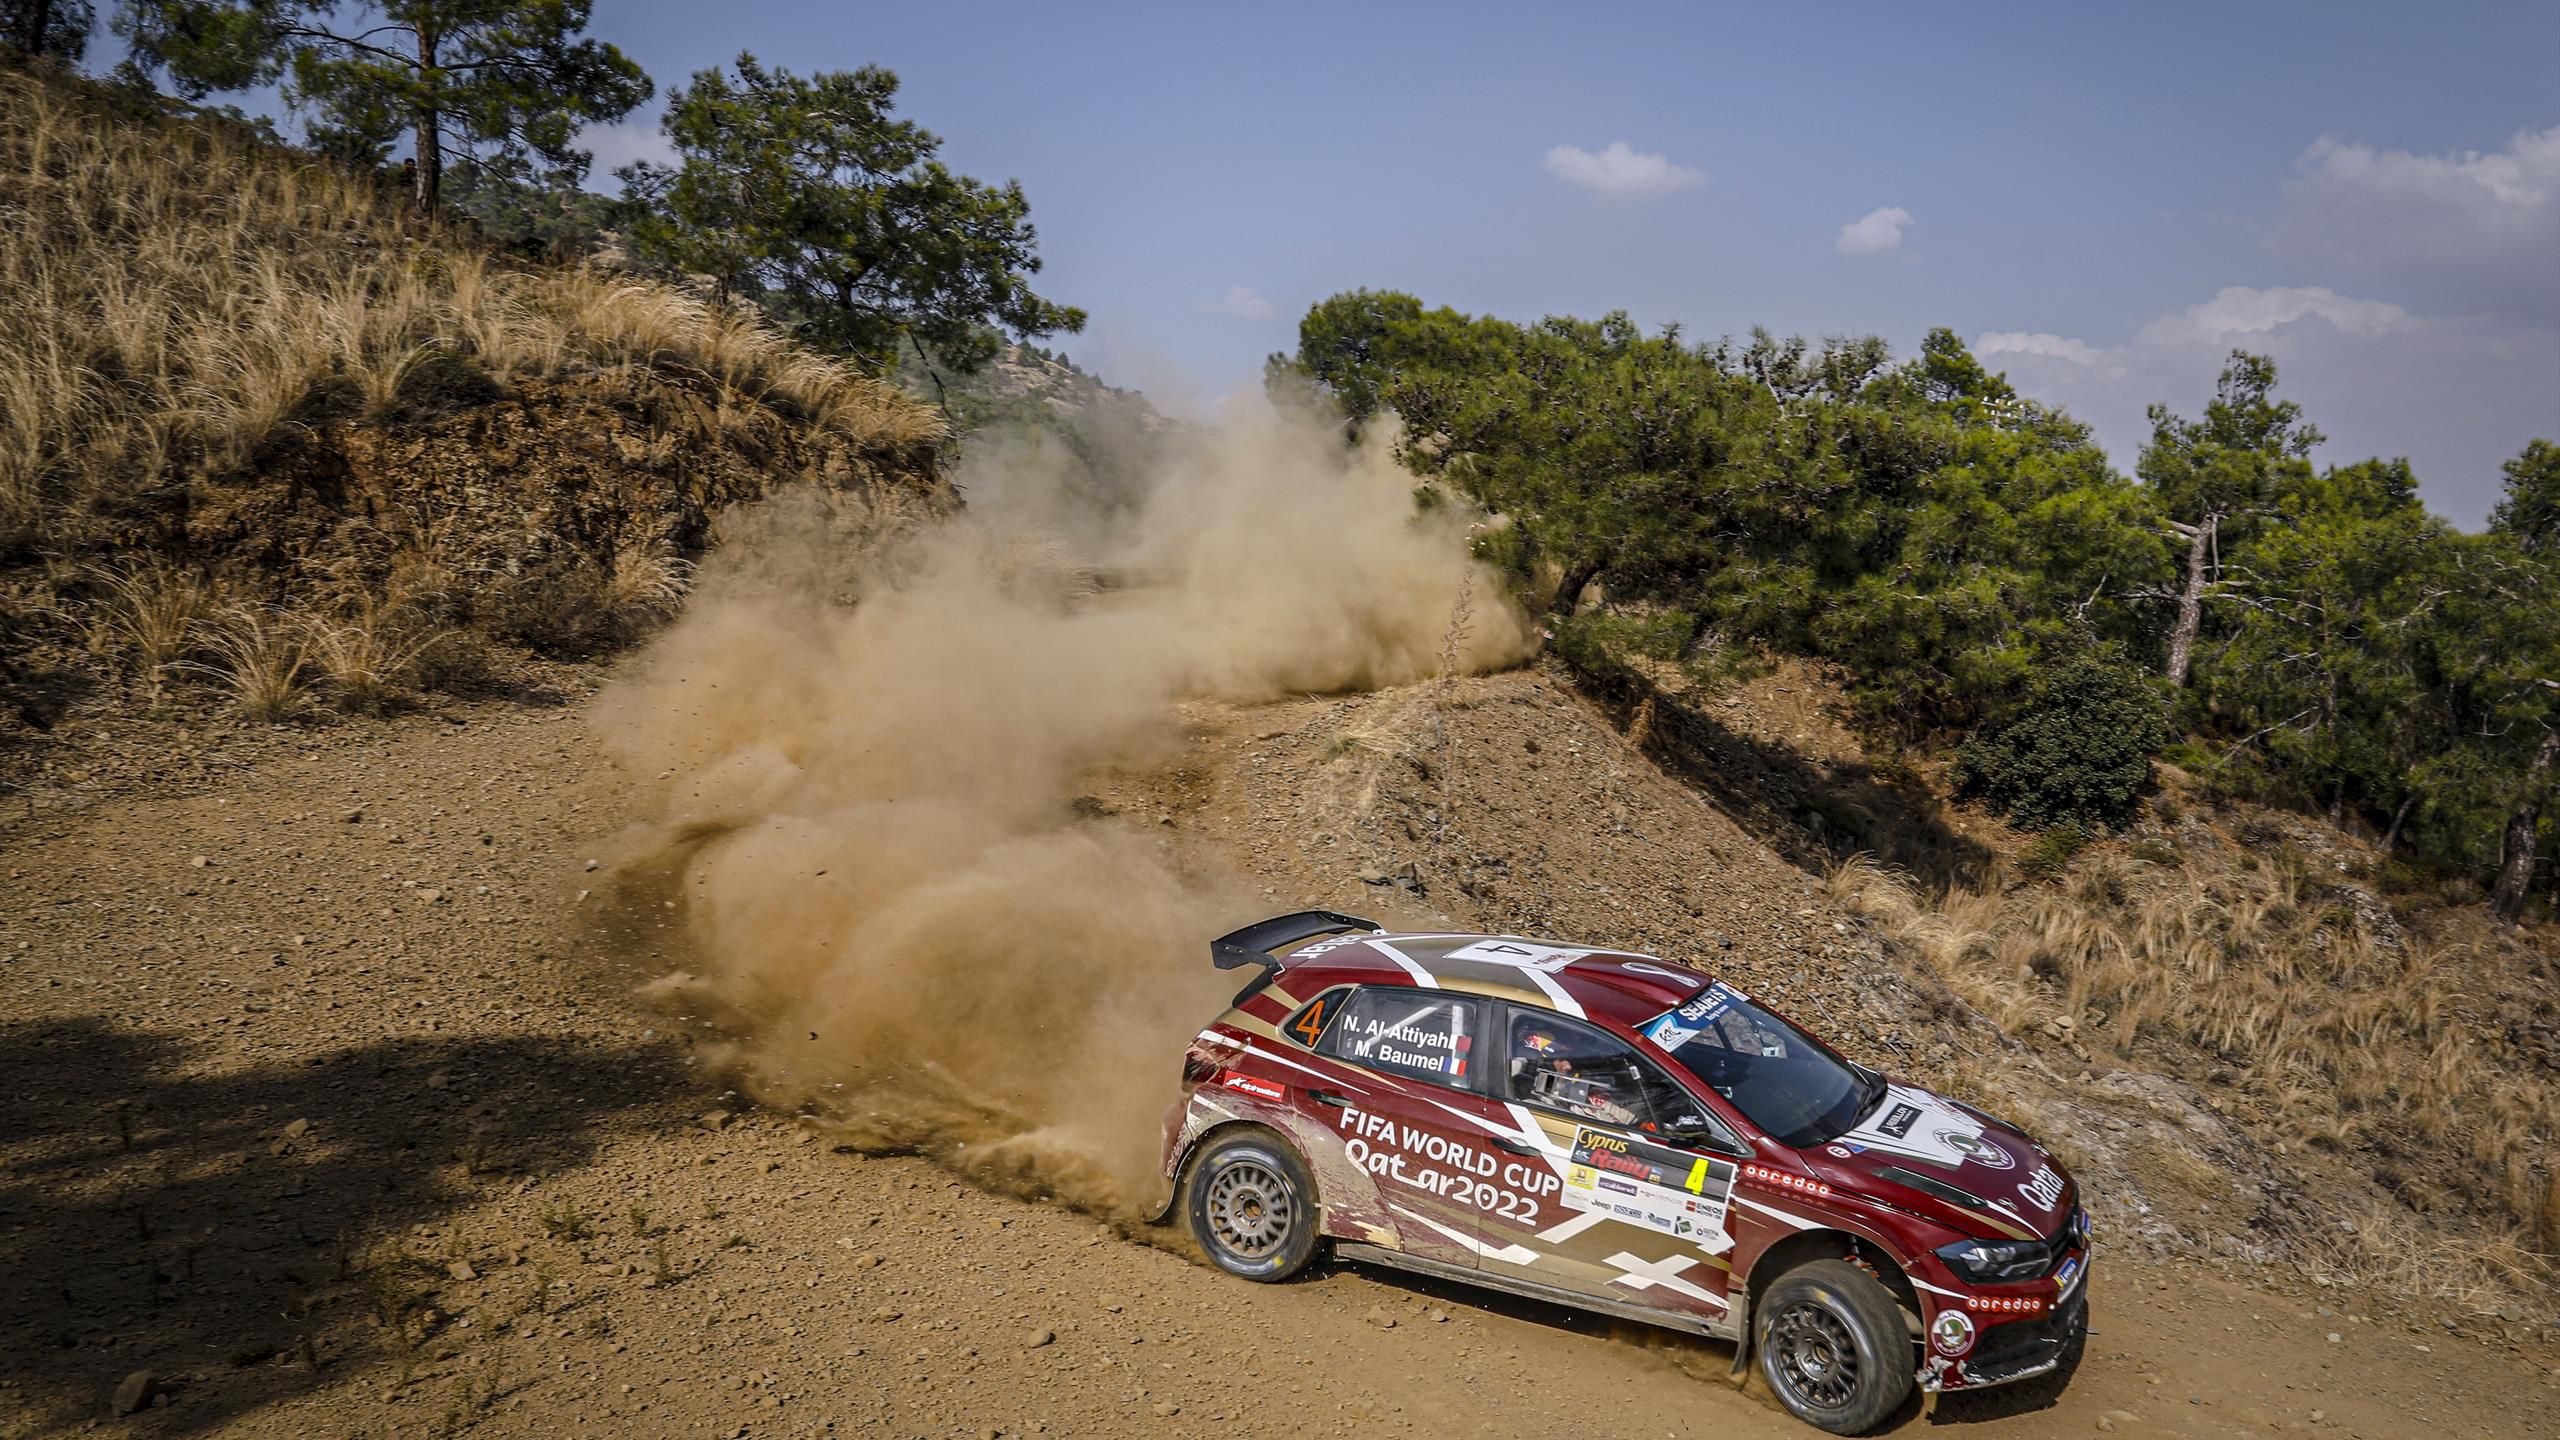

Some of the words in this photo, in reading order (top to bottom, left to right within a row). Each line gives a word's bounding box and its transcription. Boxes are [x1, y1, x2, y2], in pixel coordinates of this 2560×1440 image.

[1296, 1000, 1325, 1046] 4
[1344, 1014, 1361, 1033] N.
[1365, 1018, 1451, 1050] Al-Attiyah
[1355, 1040, 1373, 1059] M.
[1378, 1044, 1445, 1072] Baumel
[1339, 1107, 1397, 1146] FIFA
[1402, 1126, 1498, 1177] WORLD
[1503, 1163, 1560, 1197] CUP
[1578, 1129, 1629, 1154] Cyprus
[1589, 1148, 1652, 1181] Rally
[1684, 1158, 1710, 1196] 4
[1746, 1165, 1830, 1196] ooredoo
[2017, 1162, 2065, 1212] Qatar
[1591, 1199, 1611, 1210] Jeep
[1968, 1297, 2041, 1311] ooredoo
